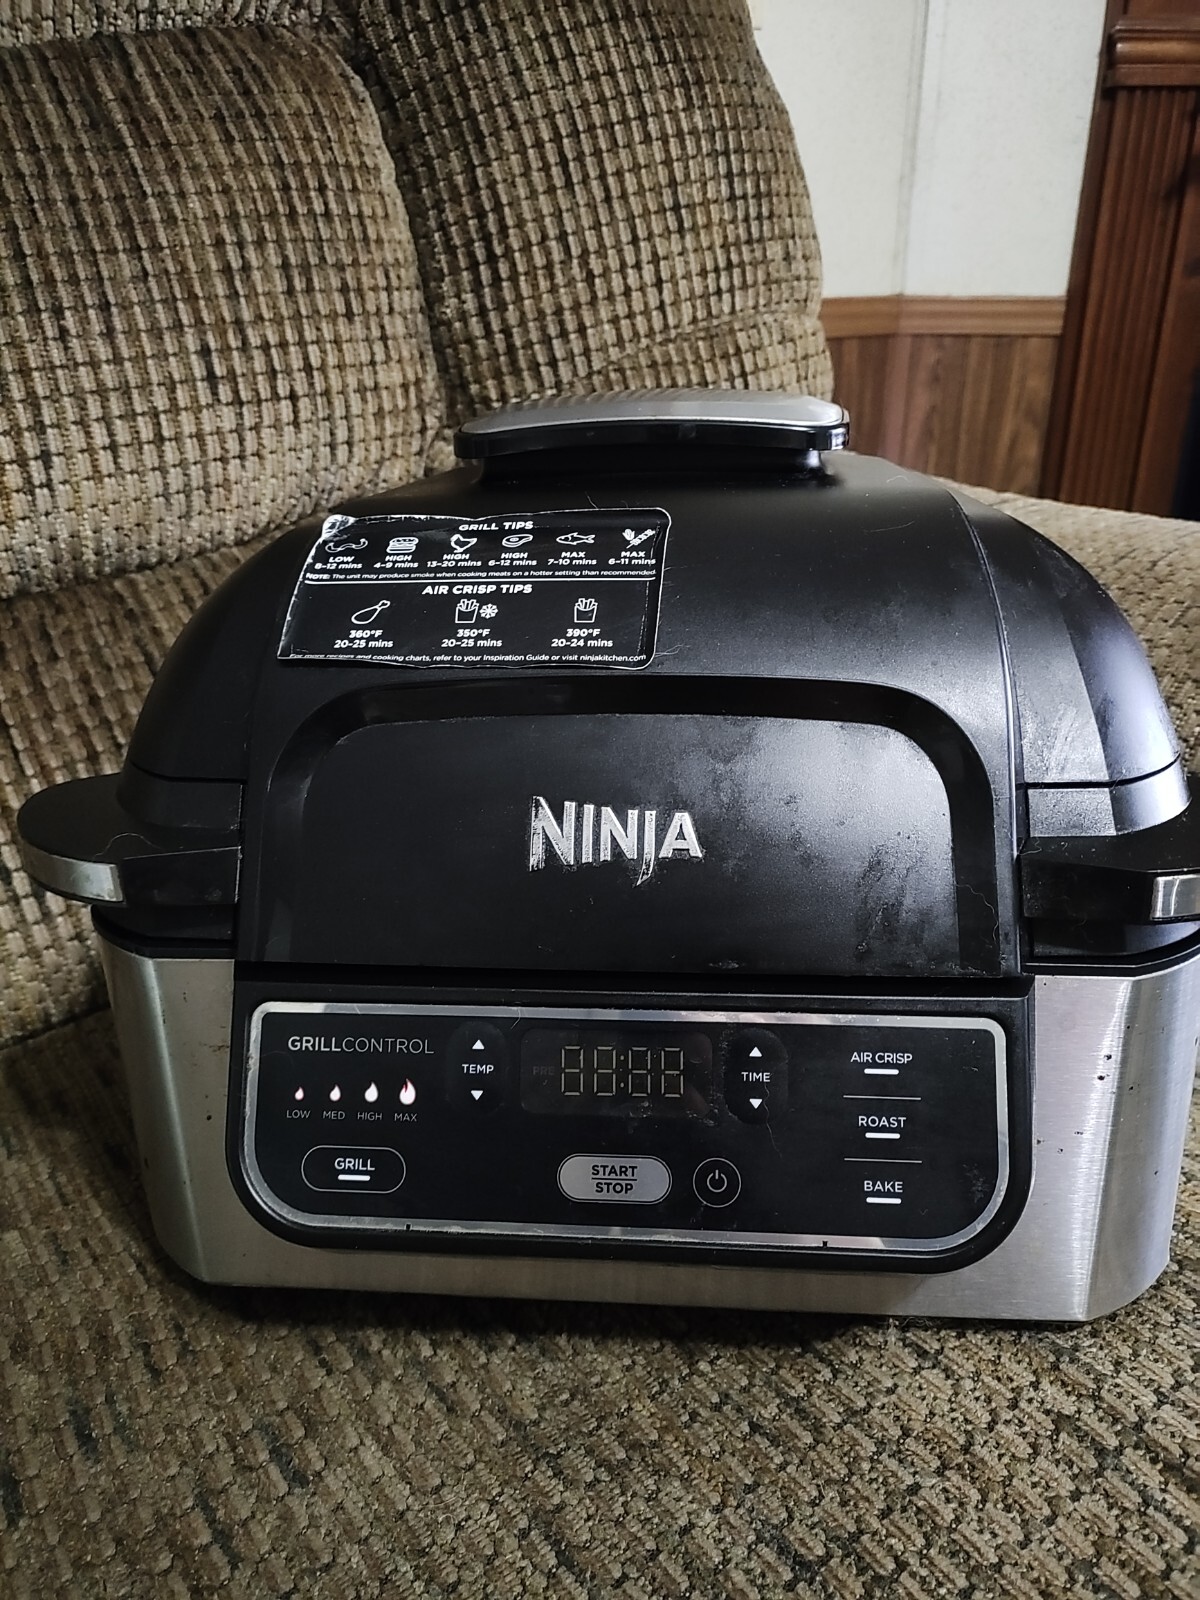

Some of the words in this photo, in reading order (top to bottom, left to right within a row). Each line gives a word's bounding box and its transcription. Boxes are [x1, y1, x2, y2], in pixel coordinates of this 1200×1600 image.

[459, 523, 499, 531] GRILL
[503, 521, 534, 530] TIPS
[314, 562, 337, 570] 8-12
[422, 585, 449, 594] AIR
[452, 584, 497, 594] CRISP
[500, 584, 532, 594] TIPS
[334, 640, 366, 648] 20-25
[441, 638, 474, 648] 20-25
[476, 638, 502, 647] mins
[551, 638, 584, 647] 20-24
[587, 638, 613, 647] mins
[529, 796, 703, 886] NINJA
[850, 1052, 872, 1063] AIR
[875, 1053, 912, 1064] CRISP
[462, 1064, 494, 1074] TEMP
[742, 1072, 770, 1082] TIME
[286, 1110, 310, 1118] LOW
[322, 1110, 346, 1120] MED
[357, 1112, 382, 1120] HIGH
[394, 1113, 417, 1122] MAX
[858, 1116, 906, 1128] ROAST
[334, 1158, 376, 1171] GRILL
[591, 1164, 638, 1178] START
[595, 1182, 634, 1194] STOP
[864, 1181, 903, 1193] BAKE
